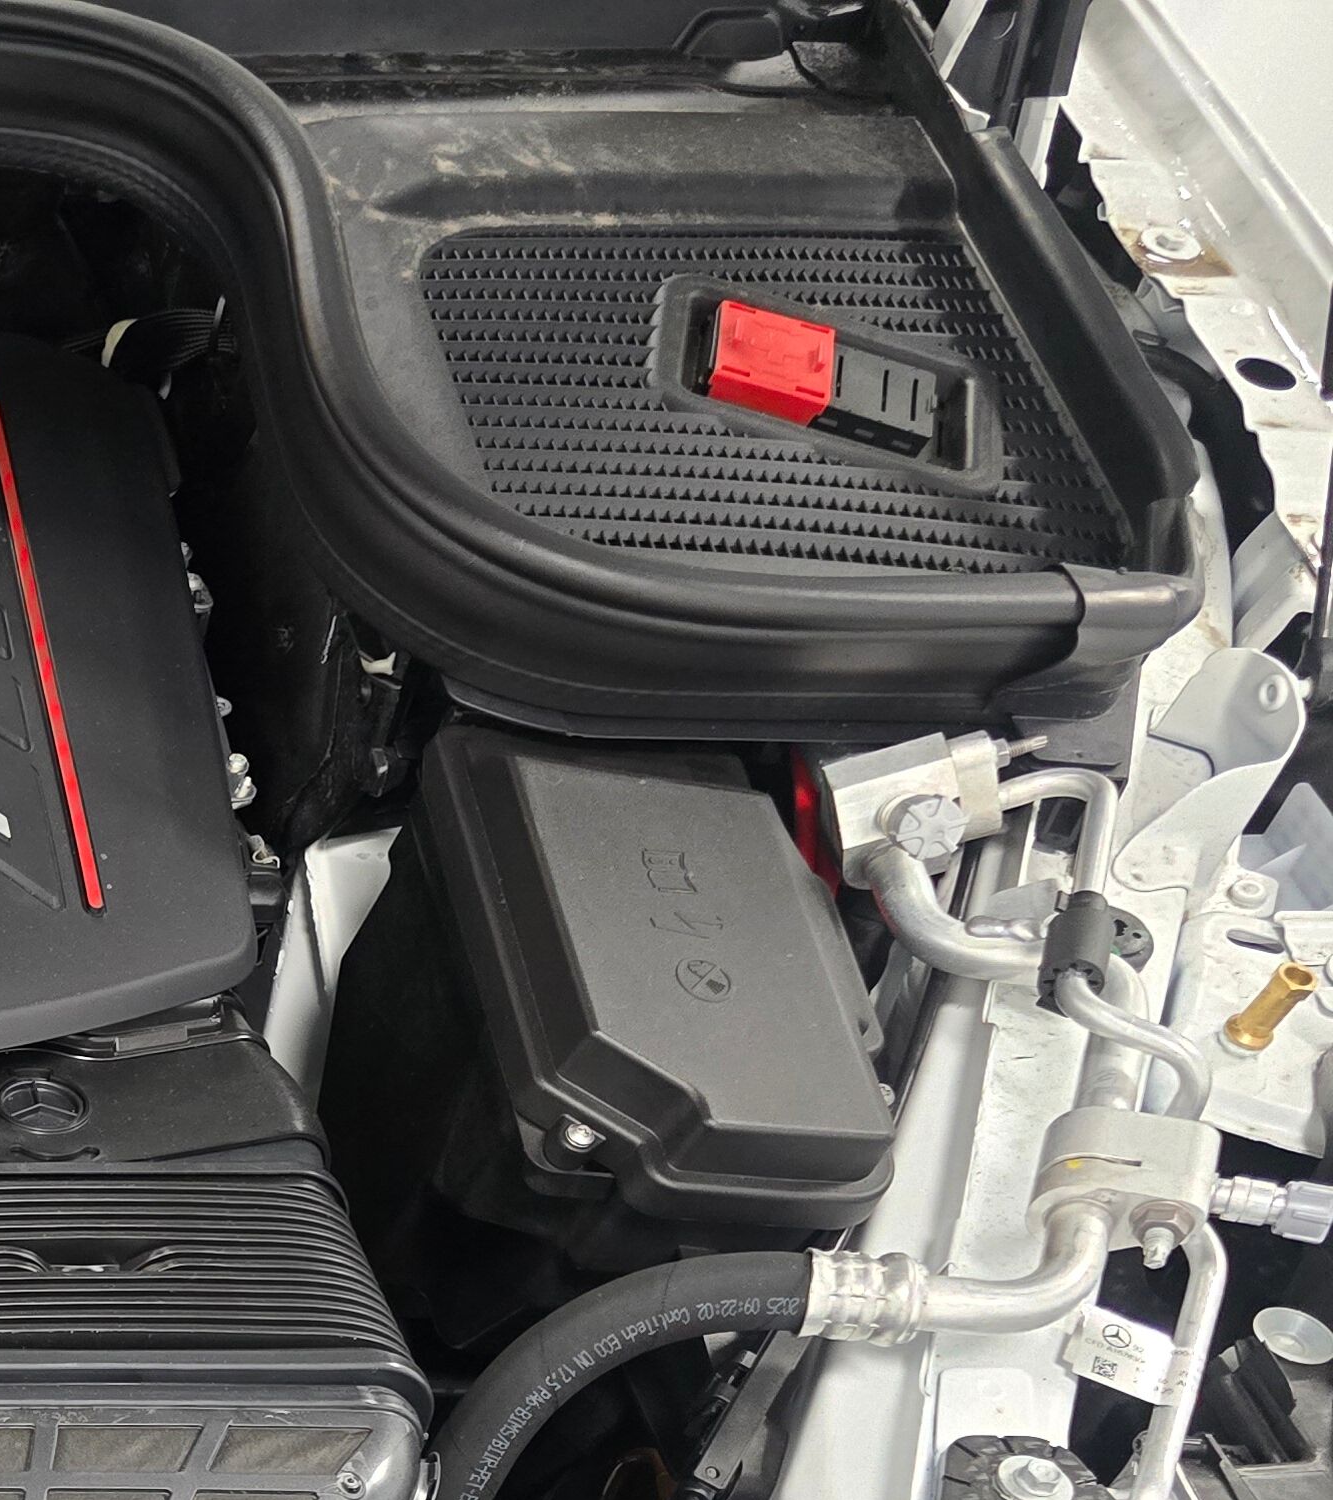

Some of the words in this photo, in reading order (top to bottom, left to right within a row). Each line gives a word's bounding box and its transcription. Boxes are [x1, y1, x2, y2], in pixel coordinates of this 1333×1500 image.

[696, 1297, 761, 1322] 09:22:02
[623, 1307, 691, 1341] ContiTech
[593, 1333, 623, 1358] ECO
[572, 1349, 596, 1371] DN
[545, 1364, 577, 1392] 17,5
